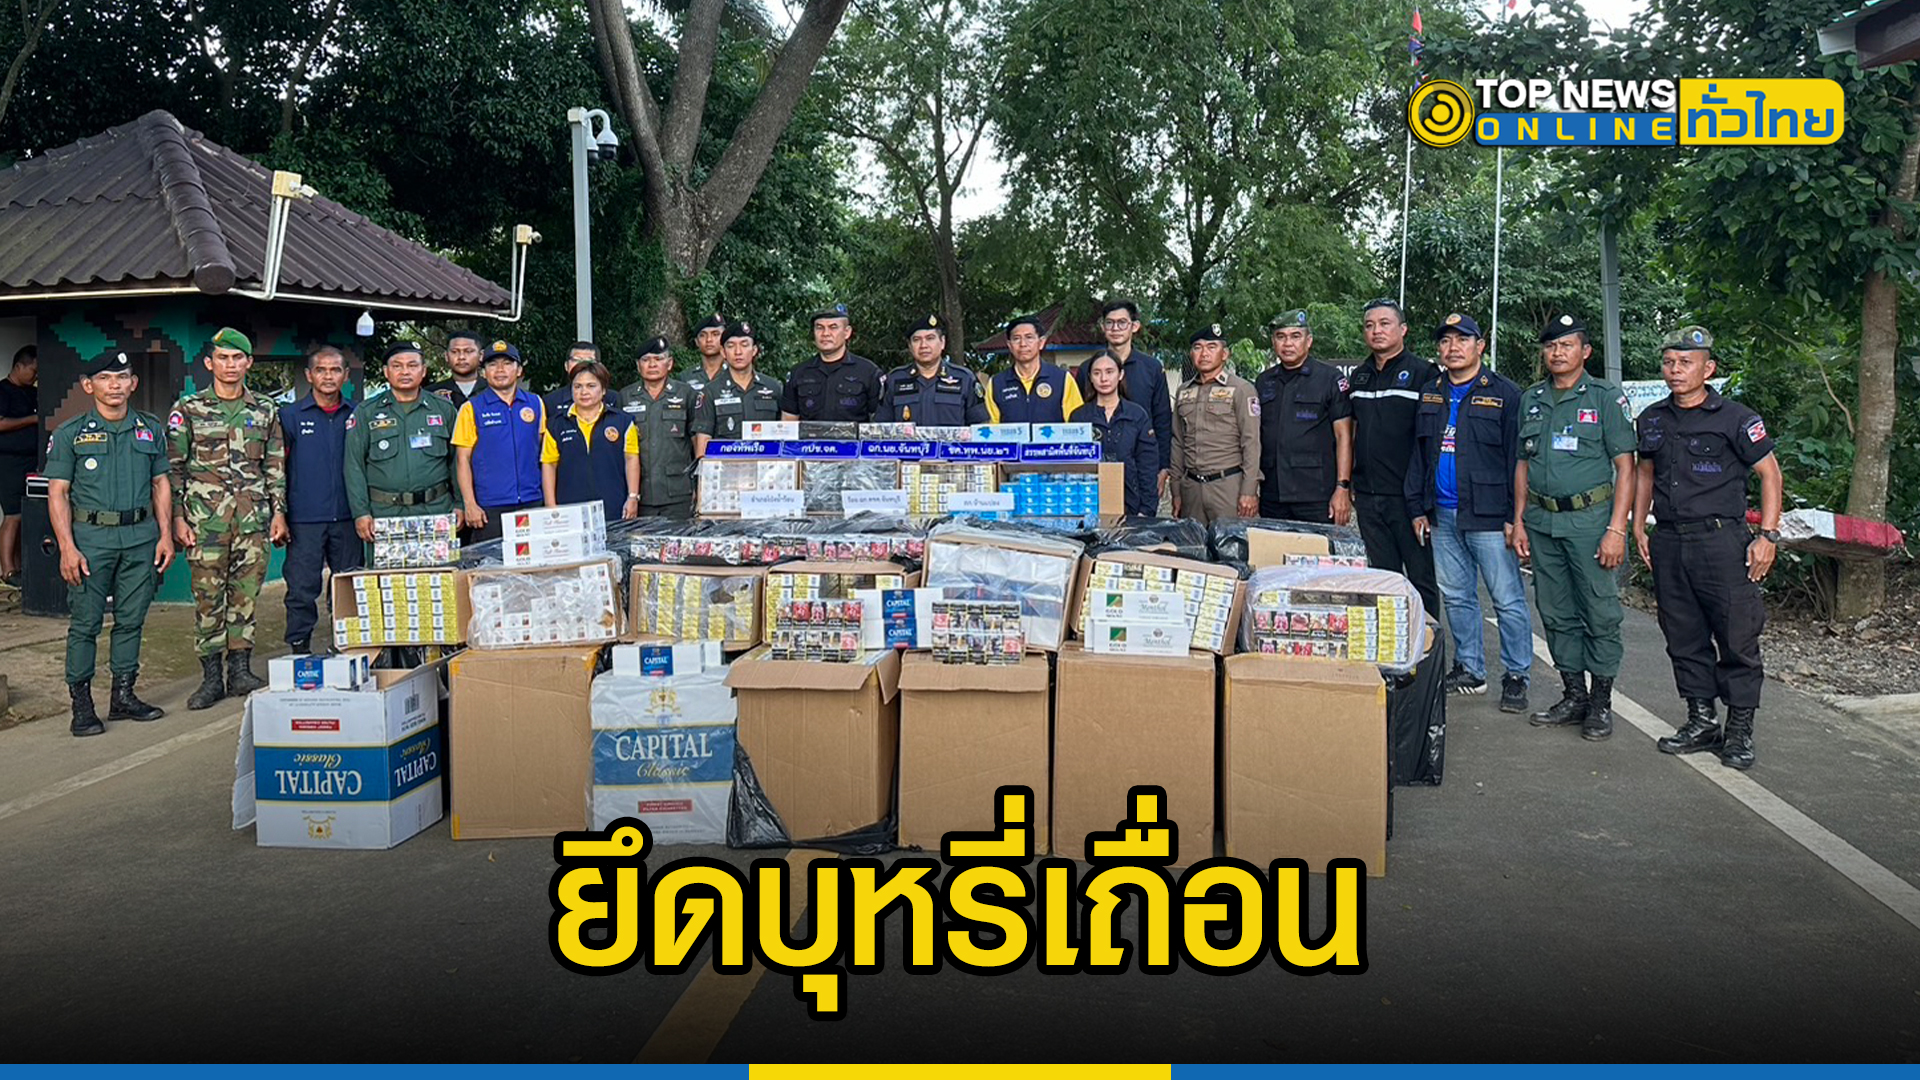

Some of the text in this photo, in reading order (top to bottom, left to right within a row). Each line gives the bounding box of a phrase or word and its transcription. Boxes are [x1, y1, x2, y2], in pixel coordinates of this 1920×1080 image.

[885, 599, 911, 608] CAPITAL
[888, 628, 913, 637] CAPITAL
[643, 655, 669, 665] CAPITAL
[615, 732, 713, 761] CAPITAL
[294, 753, 343, 769] Classic
[393, 751, 438, 788] CAPITAL
[636, 762, 690, 779] Classic
[274, 769, 363, 796] CAPITAL
